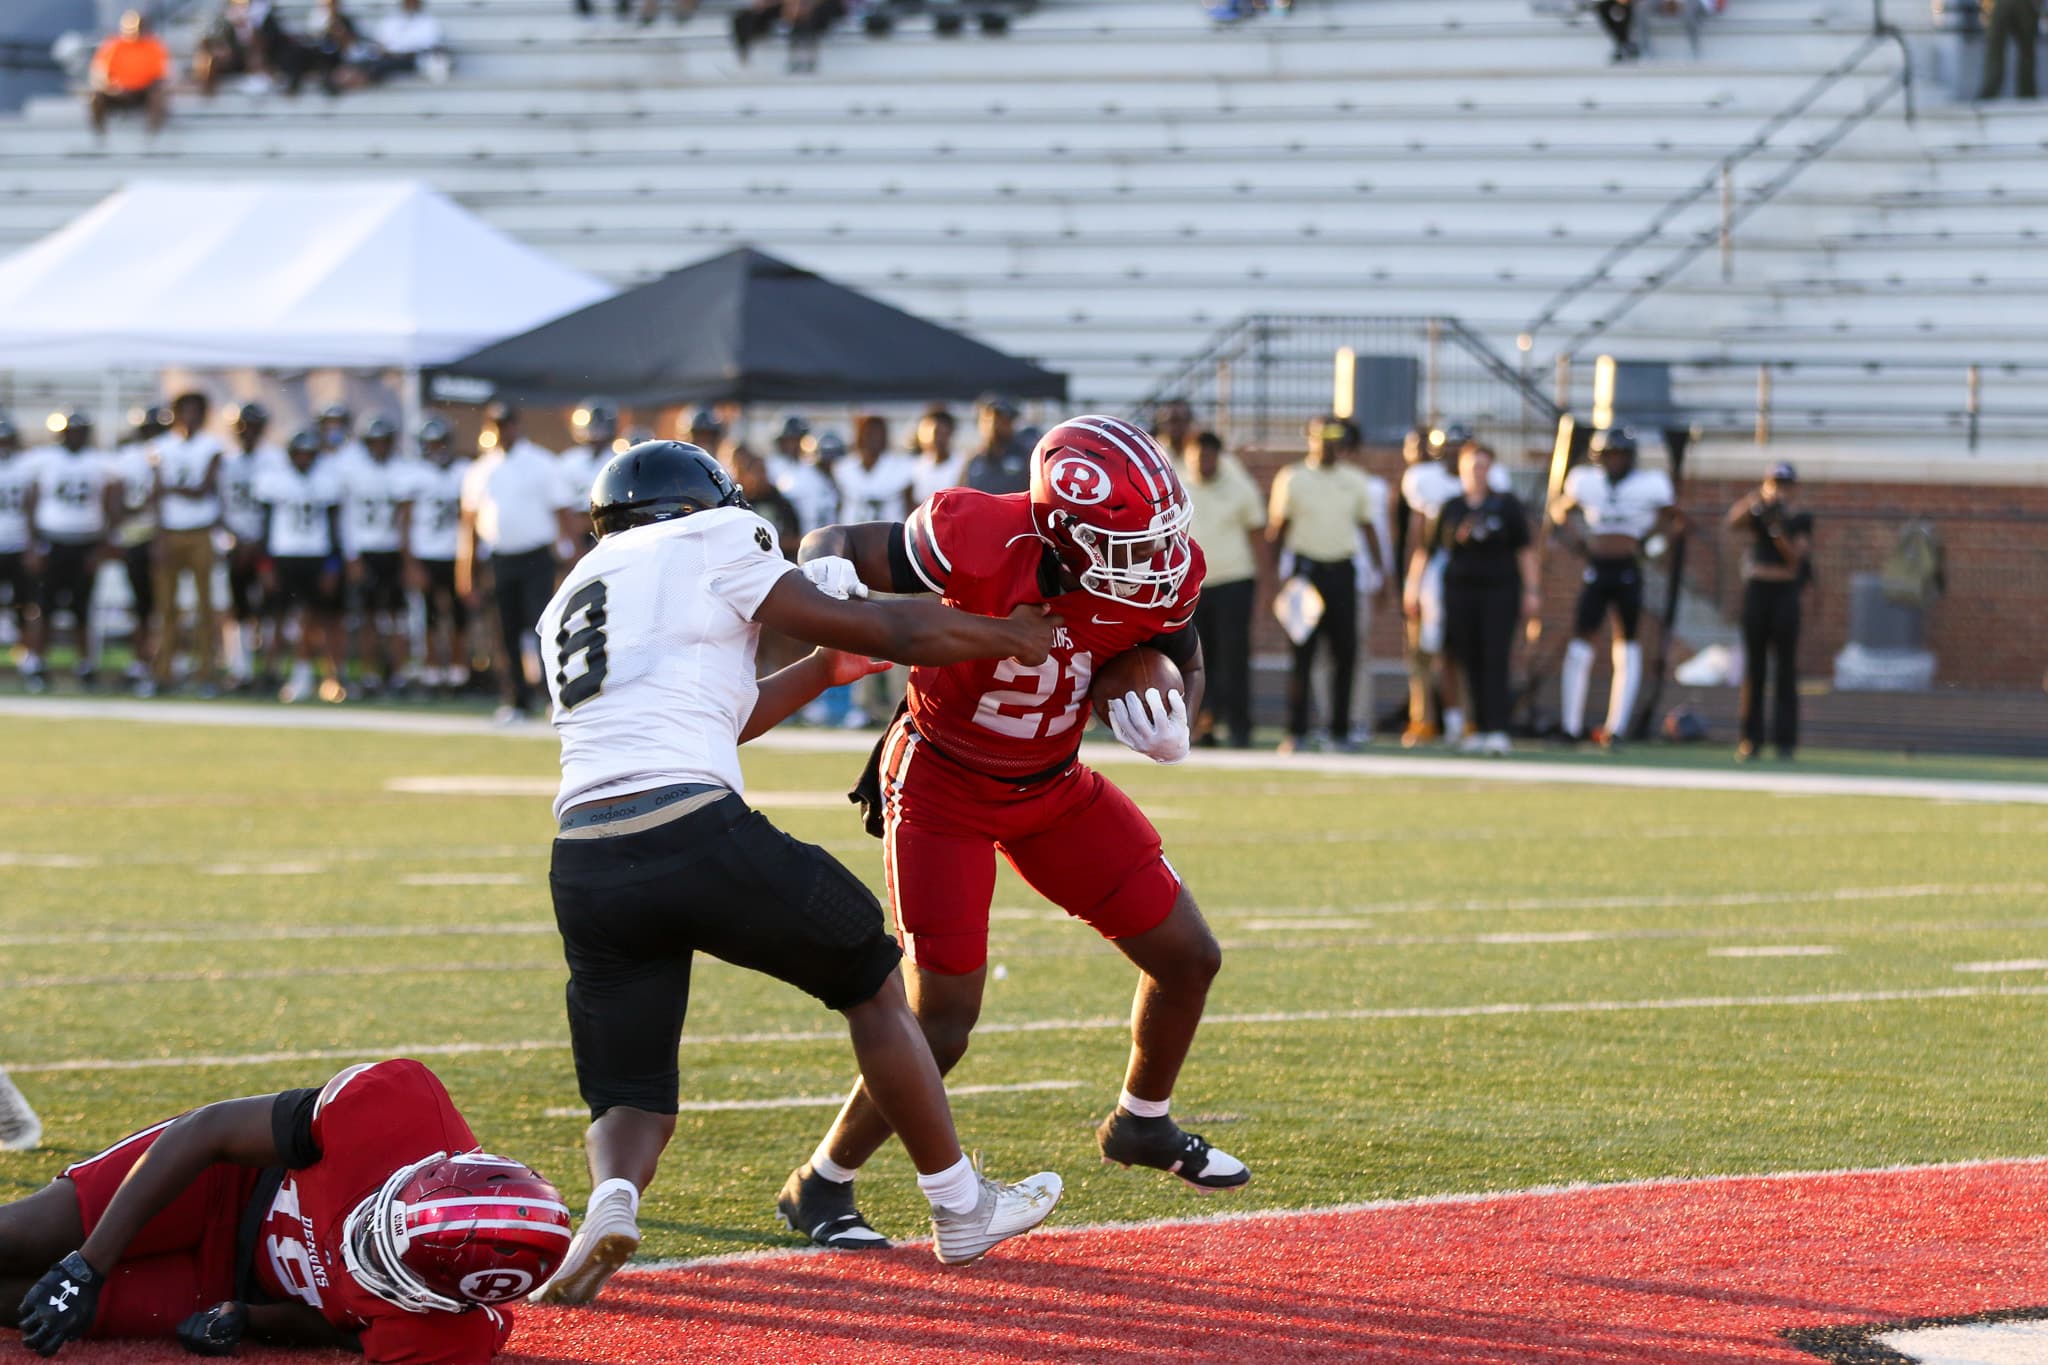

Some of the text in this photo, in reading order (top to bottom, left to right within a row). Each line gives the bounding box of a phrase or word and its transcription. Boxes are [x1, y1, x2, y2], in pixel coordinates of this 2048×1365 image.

[1160, 511, 1175, 525] WAR
[556, 577, 608, 712] 8
[971, 650, 1092, 739] 21
[393, 1212, 404, 1237] WAR
